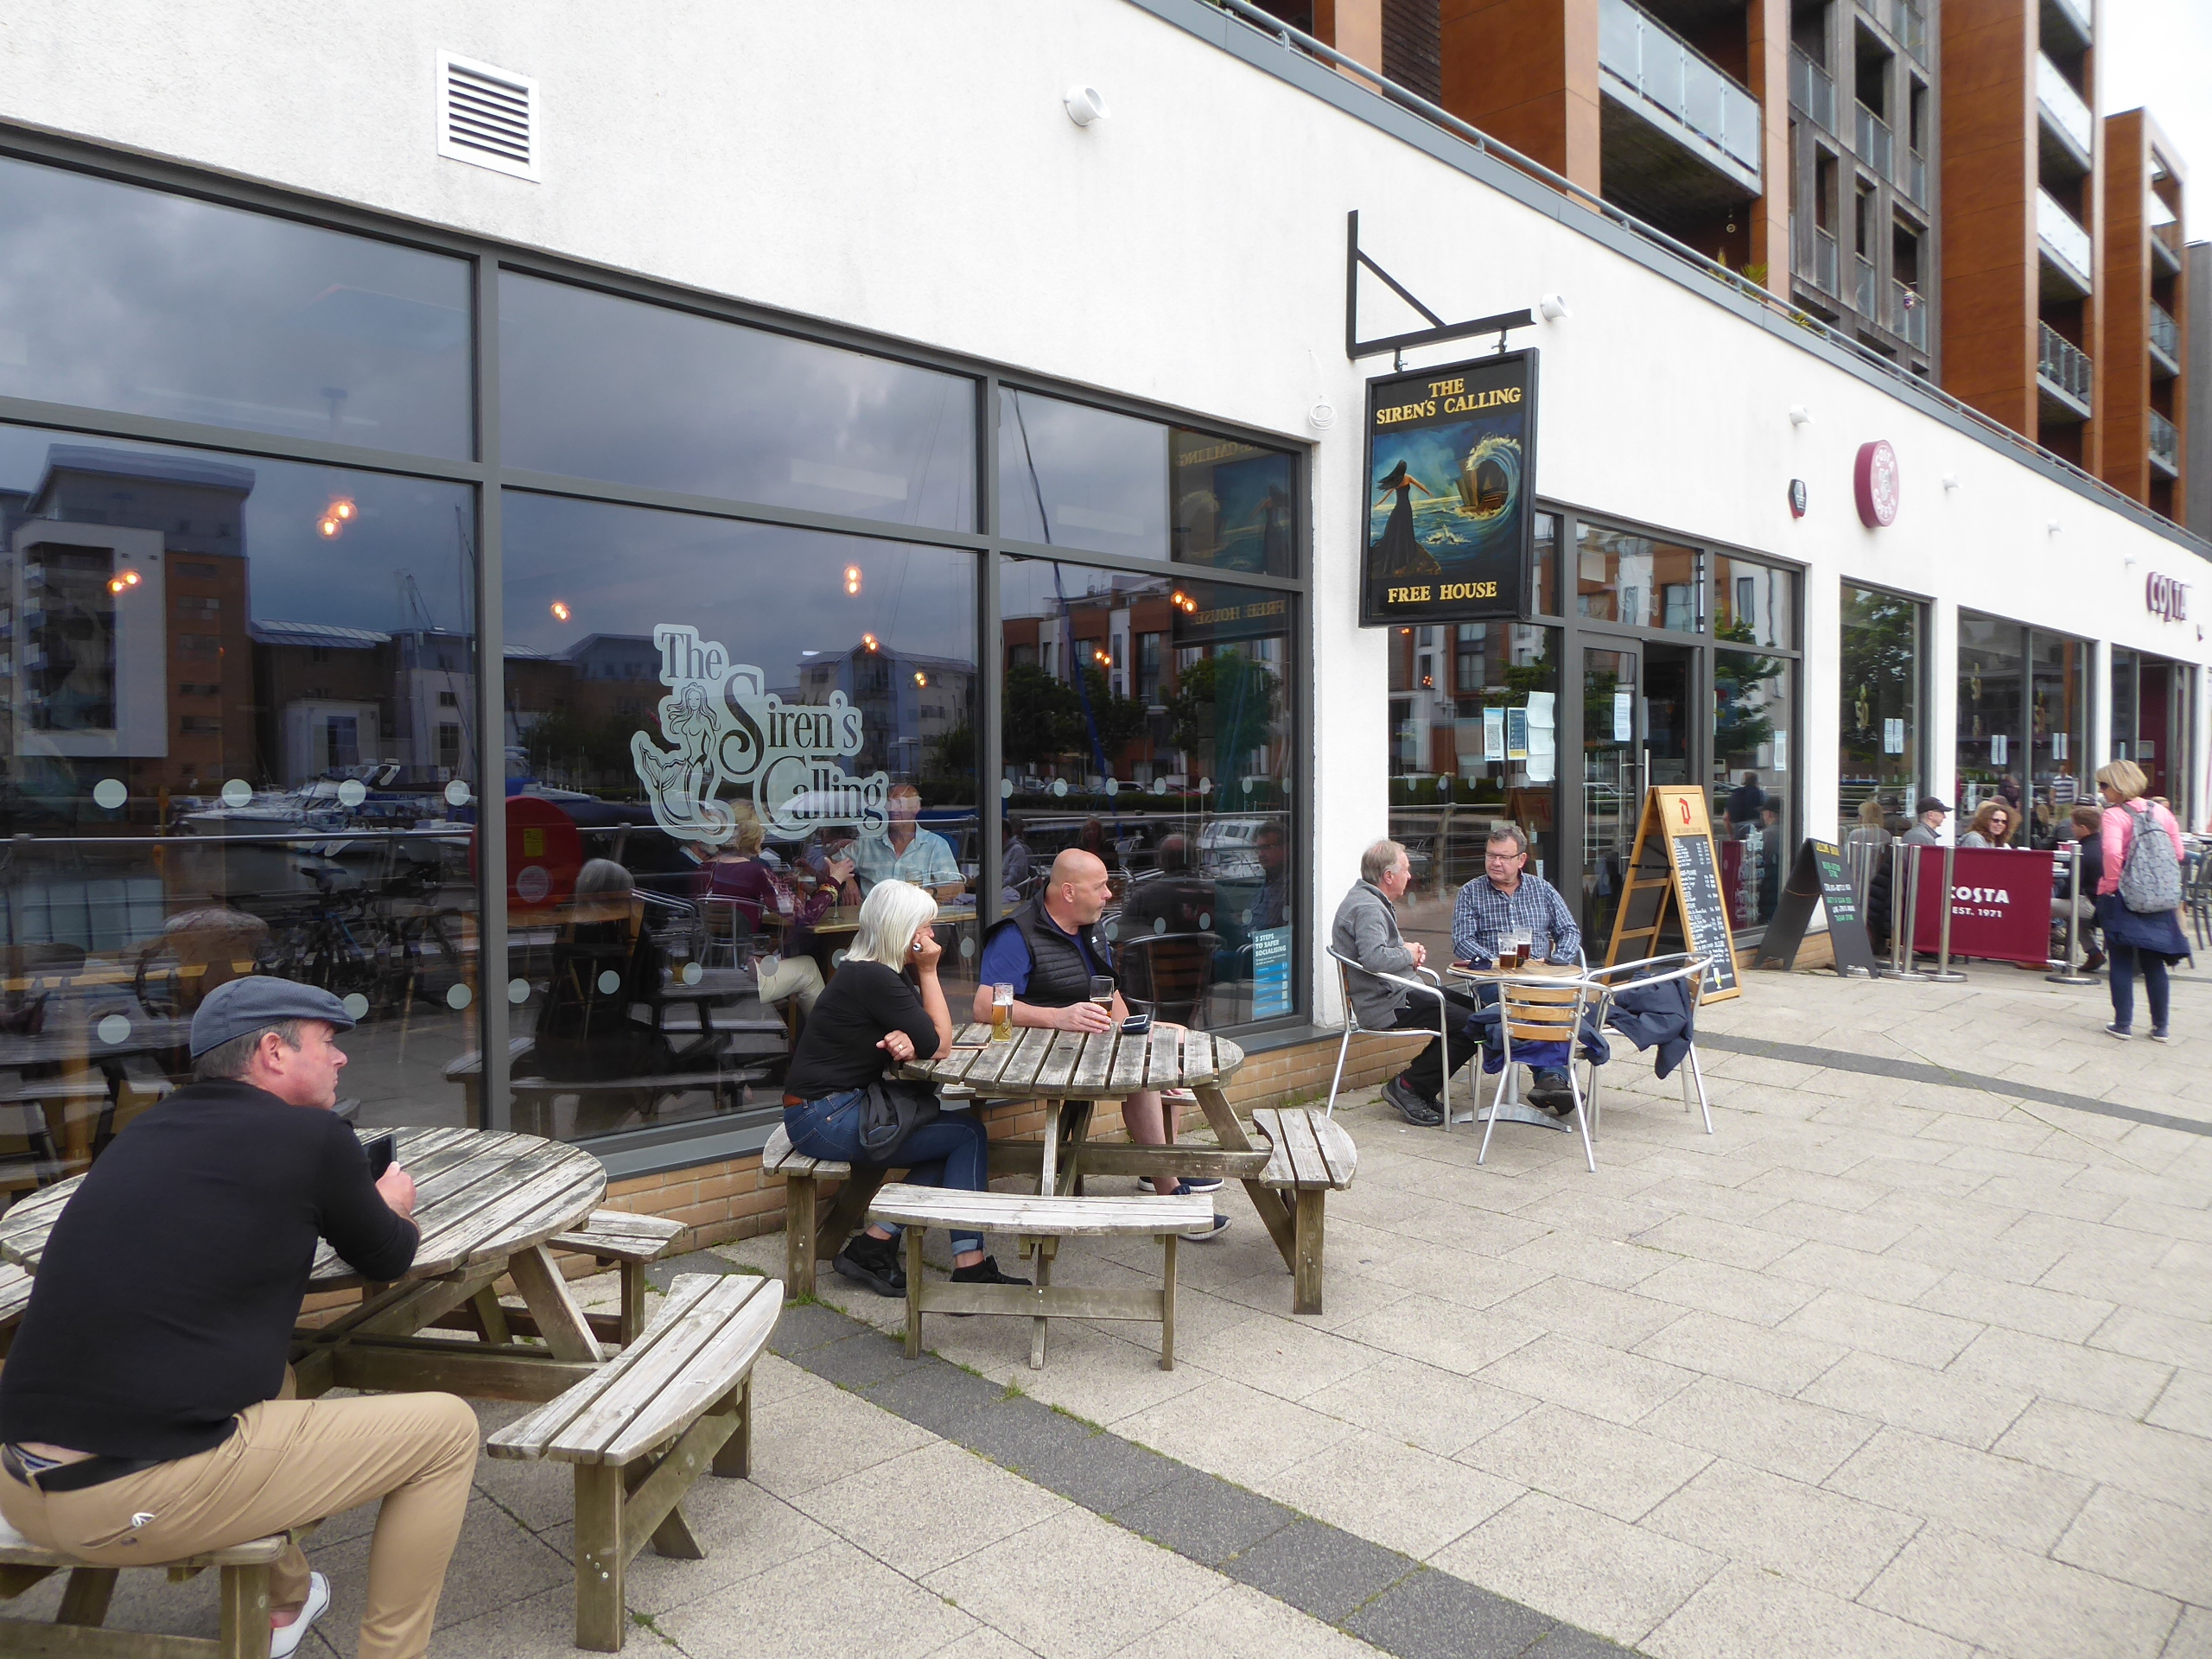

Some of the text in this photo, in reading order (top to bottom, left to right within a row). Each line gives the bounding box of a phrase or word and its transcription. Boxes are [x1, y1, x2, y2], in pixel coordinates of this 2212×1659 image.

[1428, 378, 1465, 397] THE
[1376, 387, 1522, 424] SIREN'S CALLING
[1388, 581, 1497, 603] FREE HOUSE
[661, 632, 722, 680] The
[719, 672, 858, 775] Siren's
[760, 755, 883, 831] Calling
[1952, 906, 2003, 918] EST. 1971
[1255, 945, 1286, 957] SOCIALISING
[1264, 939, 1280, 948] SAFER
